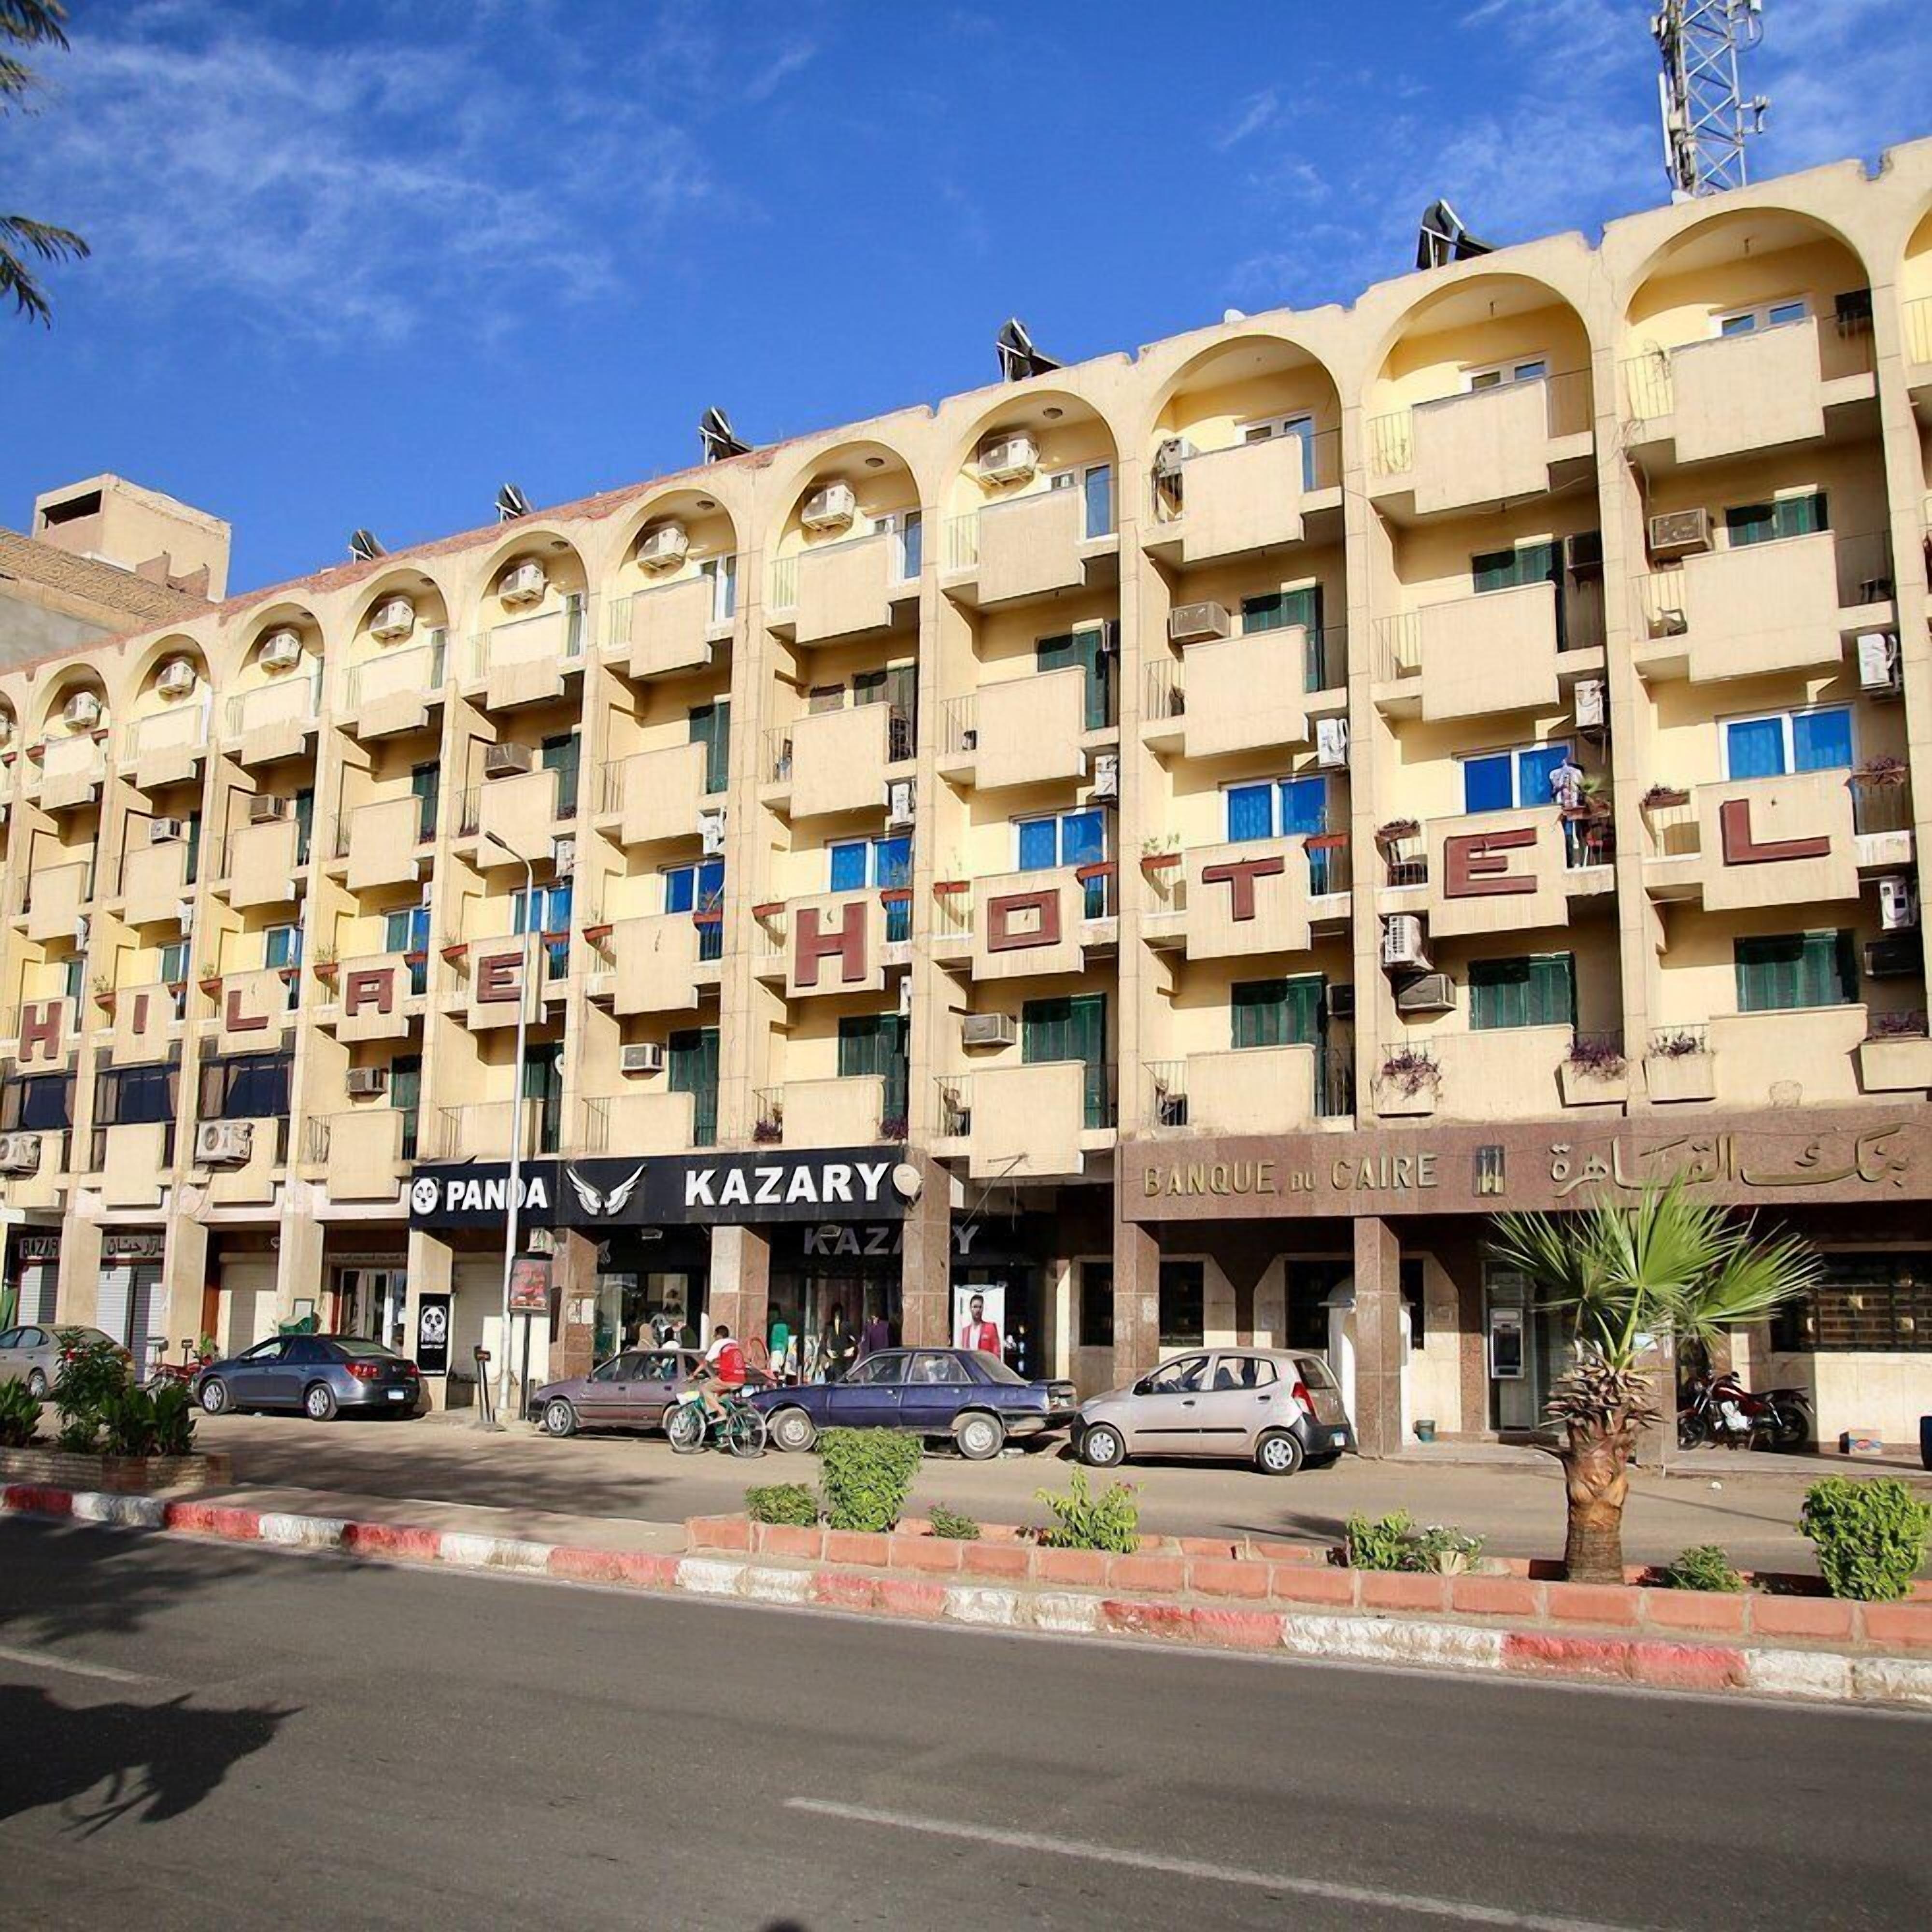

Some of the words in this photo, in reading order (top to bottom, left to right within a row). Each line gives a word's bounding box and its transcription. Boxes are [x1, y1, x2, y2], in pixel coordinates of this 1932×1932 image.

[795, 799, 1832, 987] HOTEL
[1143, 1160, 1276, 1197] BANQUE
[1331, 1153, 1439, 1190] CAIRE
[1549, 1133, 1734, 1198] القاهرة
[1741, 1123, 1910, 1188] بنك
[446, 1177, 548, 1212] PANDA
[684, 1162, 893, 1206] KAZARY
[803, 1224, 980, 1255] KAZY
